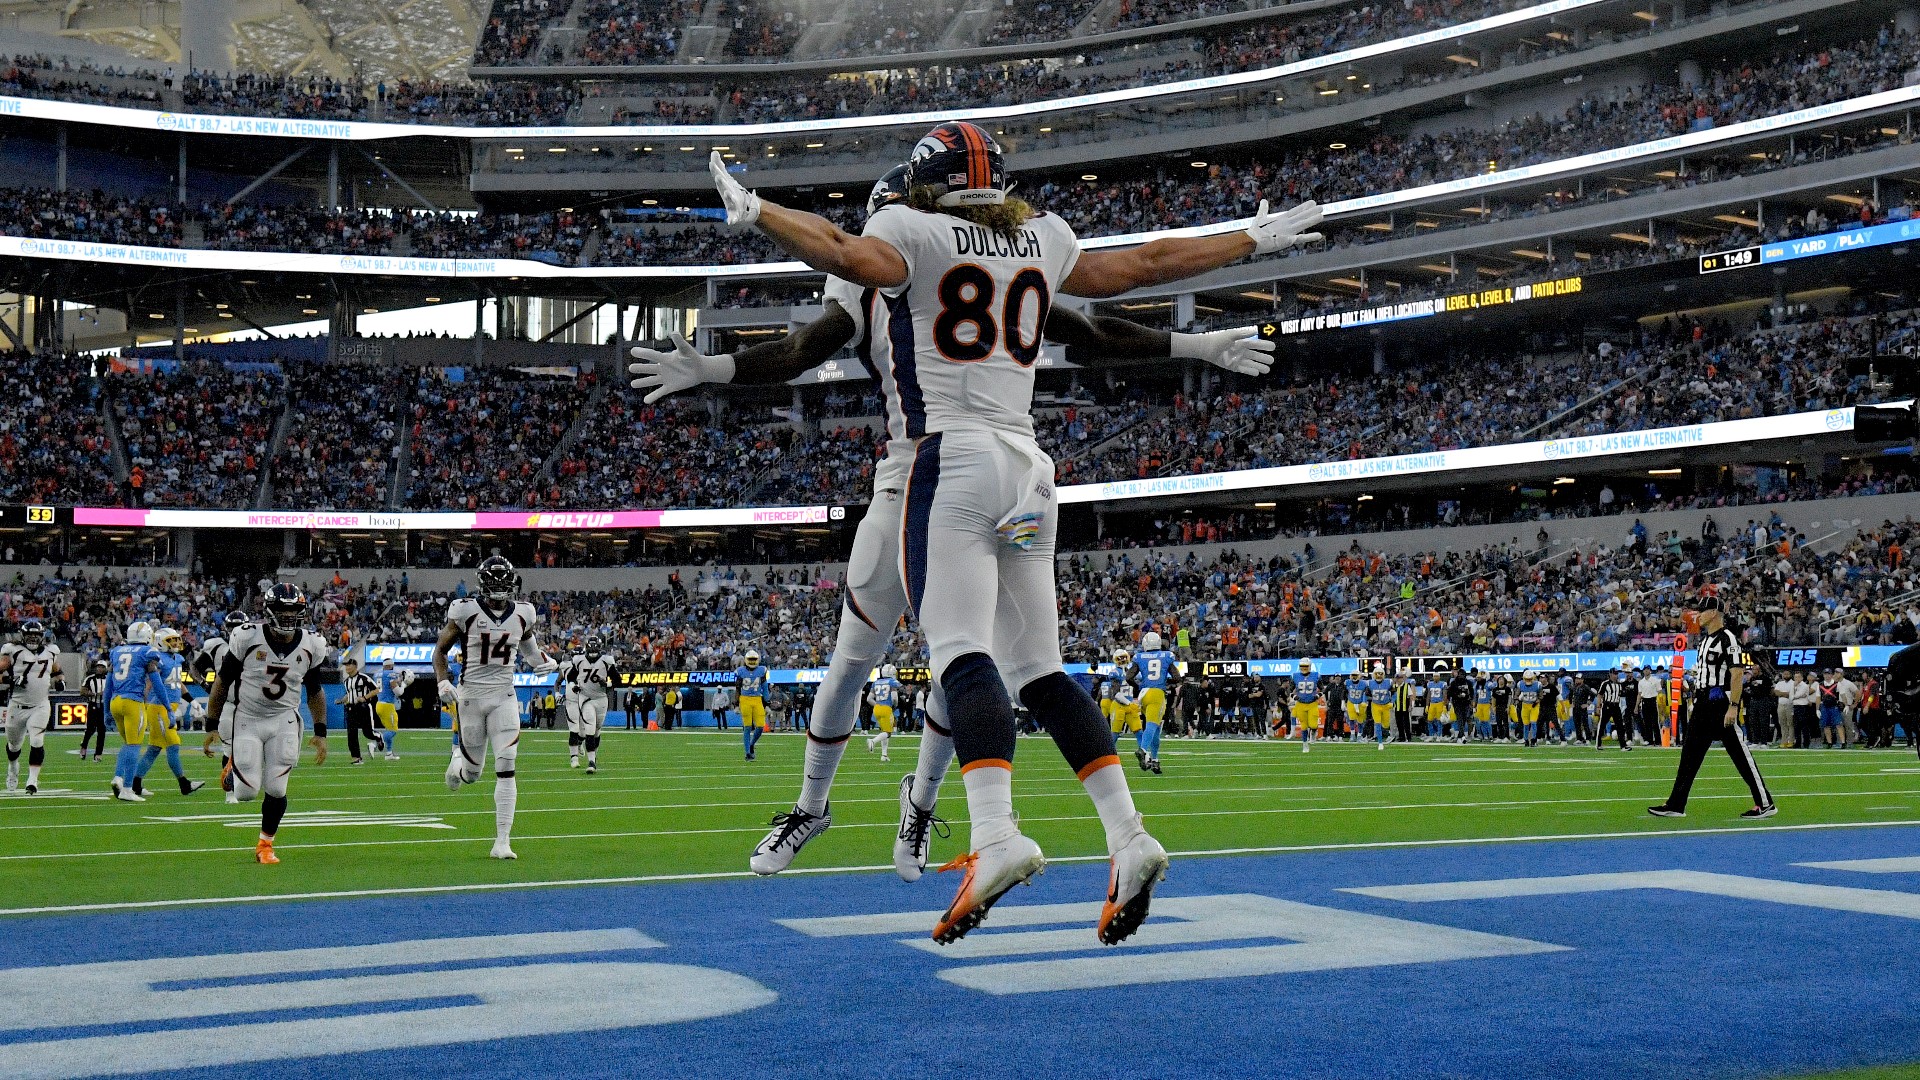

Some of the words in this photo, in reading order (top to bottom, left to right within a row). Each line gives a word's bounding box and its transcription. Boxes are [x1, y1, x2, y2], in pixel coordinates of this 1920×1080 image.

[177, 117, 197, 130] ALT
[200, 118, 221, 131] 98.7
[230, 120, 252, 132] LA'S
[255, 121, 279, 134] NEW
[282, 122, 351, 138] ALTERNATIVE
[951, 225, 1042, 258] DULCICH
[1792, 239, 1827, 255] YARD
[38, 243, 55, 253] ALT
[58, 244, 76, 254] 98.7
[84, 246, 103, 257] LA'S
[106, 246, 126, 258] NEW
[128, 248, 188, 263] ALTERNATIVE
[1723, 250, 1753, 267] 1:49
[932, 262, 1051, 368] 80
[1280, 320, 1300, 334] VISIT
[1300, 317, 1316, 332] ANY
[1316, 316, 1326, 330] OF
[1326, 314, 1341, 328] OUR
[1341, 310, 1359, 326] BOLT
[1360, 308, 1376, 322] FAM
[1376, 306, 1394, 320] INFO
[1394, 300, 1434, 318] LOCATIONS
[1434, 298, 1446, 312] ON
[1446, 294, 1470, 311] LEVEL
[1480, 290, 1504, 306] LEVEL
[1514, 285, 1532, 301] AND
[1532, 281, 1555, 298] PATIO
[1555, 276, 1582, 295] CLUBS
[1559, 441, 1574, 456] ALT
[1576, 440, 1593, 453] 98.7
[1600, 437, 1619, 451] LA'S
[1620, 434, 1641, 449] NEW
[1643, 428, 1703, 447] ALTERNATIVE
[1323, 466, 1337, 478] ALT
[1338, 464, 1353, 476] 98.7
[1358, 462, 1374, 474] LA'S
[1376, 460, 1393, 472] NEW
[1395, 454, 1446, 470] ALTERNATIVE
[1114, 484, 1128, 496] ALT
[1128, 483, 1142, 494] 98.7
[1148, 481, 1162, 493] LA'S
[1162, 480, 1178, 492] NEW
[1180, 475, 1224, 490] ALTERNATIVE
[30, 508, 52, 521] 39
[248, 516, 305, 526] INTERCEPT
[317, 516, 359, 526] CANCER
[753, 510, 805, 522] INTERCEPT
[831, 509, 843, 518] CC
[480, 632, 512, 665] 14
[22, 659, 48, 679] 77
[114, 653, 132, 681] 3
[1147, 659, 1162, 681] 9
[1222, 663, 1242, 674] 1:49
[1268, 664, 1292, 674] YARD
[1498, 658, 1512, 669] 10
[1519, 659, 1541, 668] BALL
[1542, 658, 1556, 667] ON
[262, 665, 289, 701] 3
[583, 668, 600, 684] 76
[631, 672, 688, 685] ANGELES
[61, 705, 87, 725] 39
